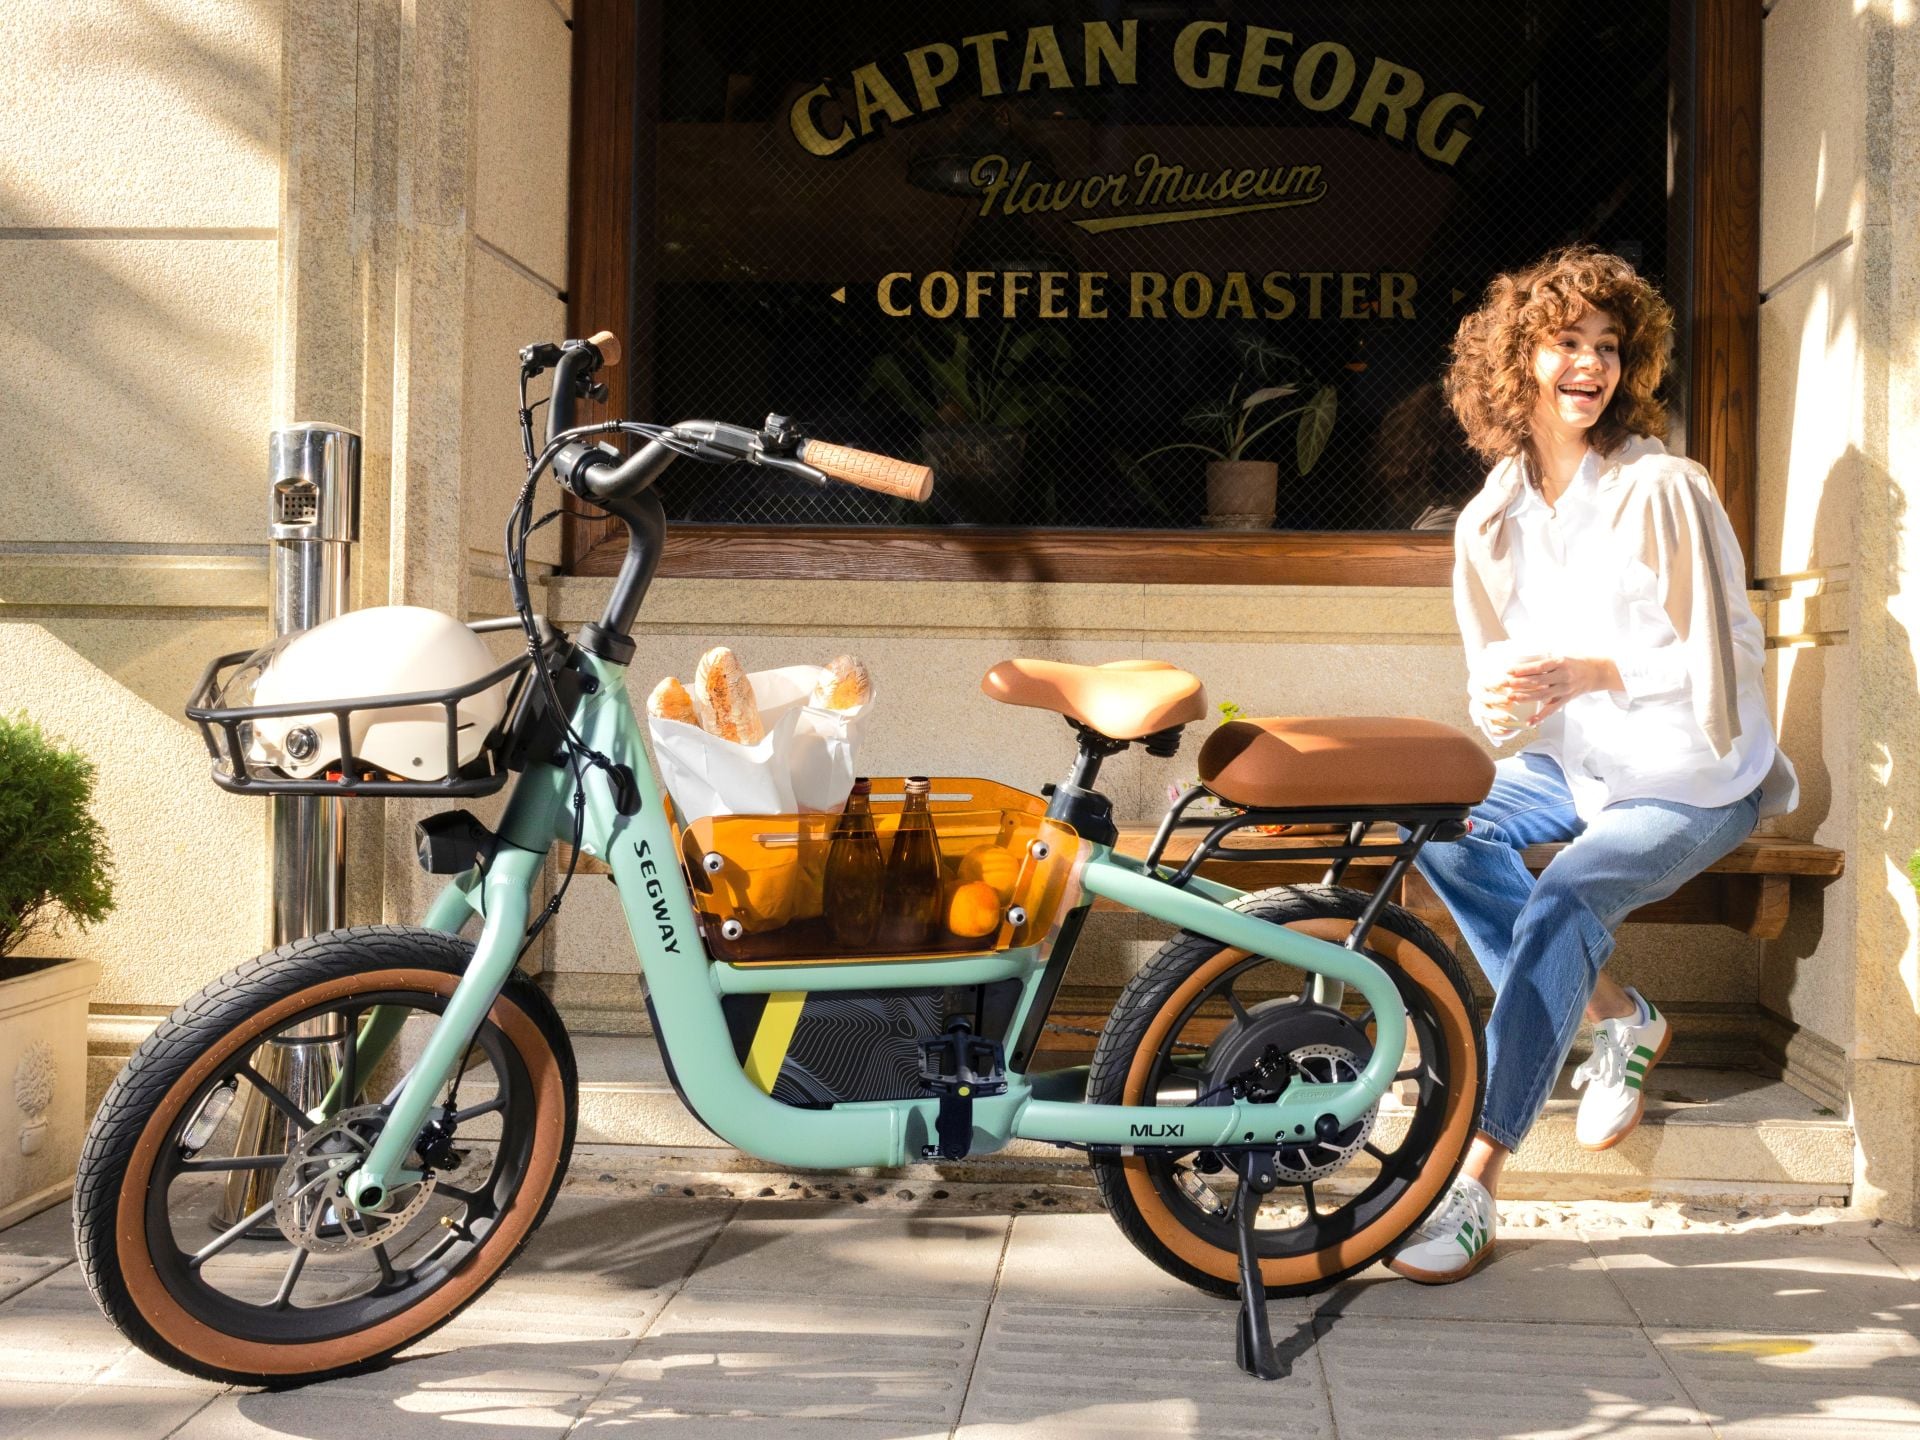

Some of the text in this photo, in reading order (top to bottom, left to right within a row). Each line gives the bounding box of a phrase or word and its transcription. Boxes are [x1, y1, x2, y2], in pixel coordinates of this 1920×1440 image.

[790, 20, 1484, 166] CAPTAN GEORG
[970, 153, 1328, 217] Flavor Museum
[877, 271, 1418, 320] COFFEE ROASTER
[634, 839, 681, 954] SEGWAY
[1130, 1124, 1185, 1137] MUXI
